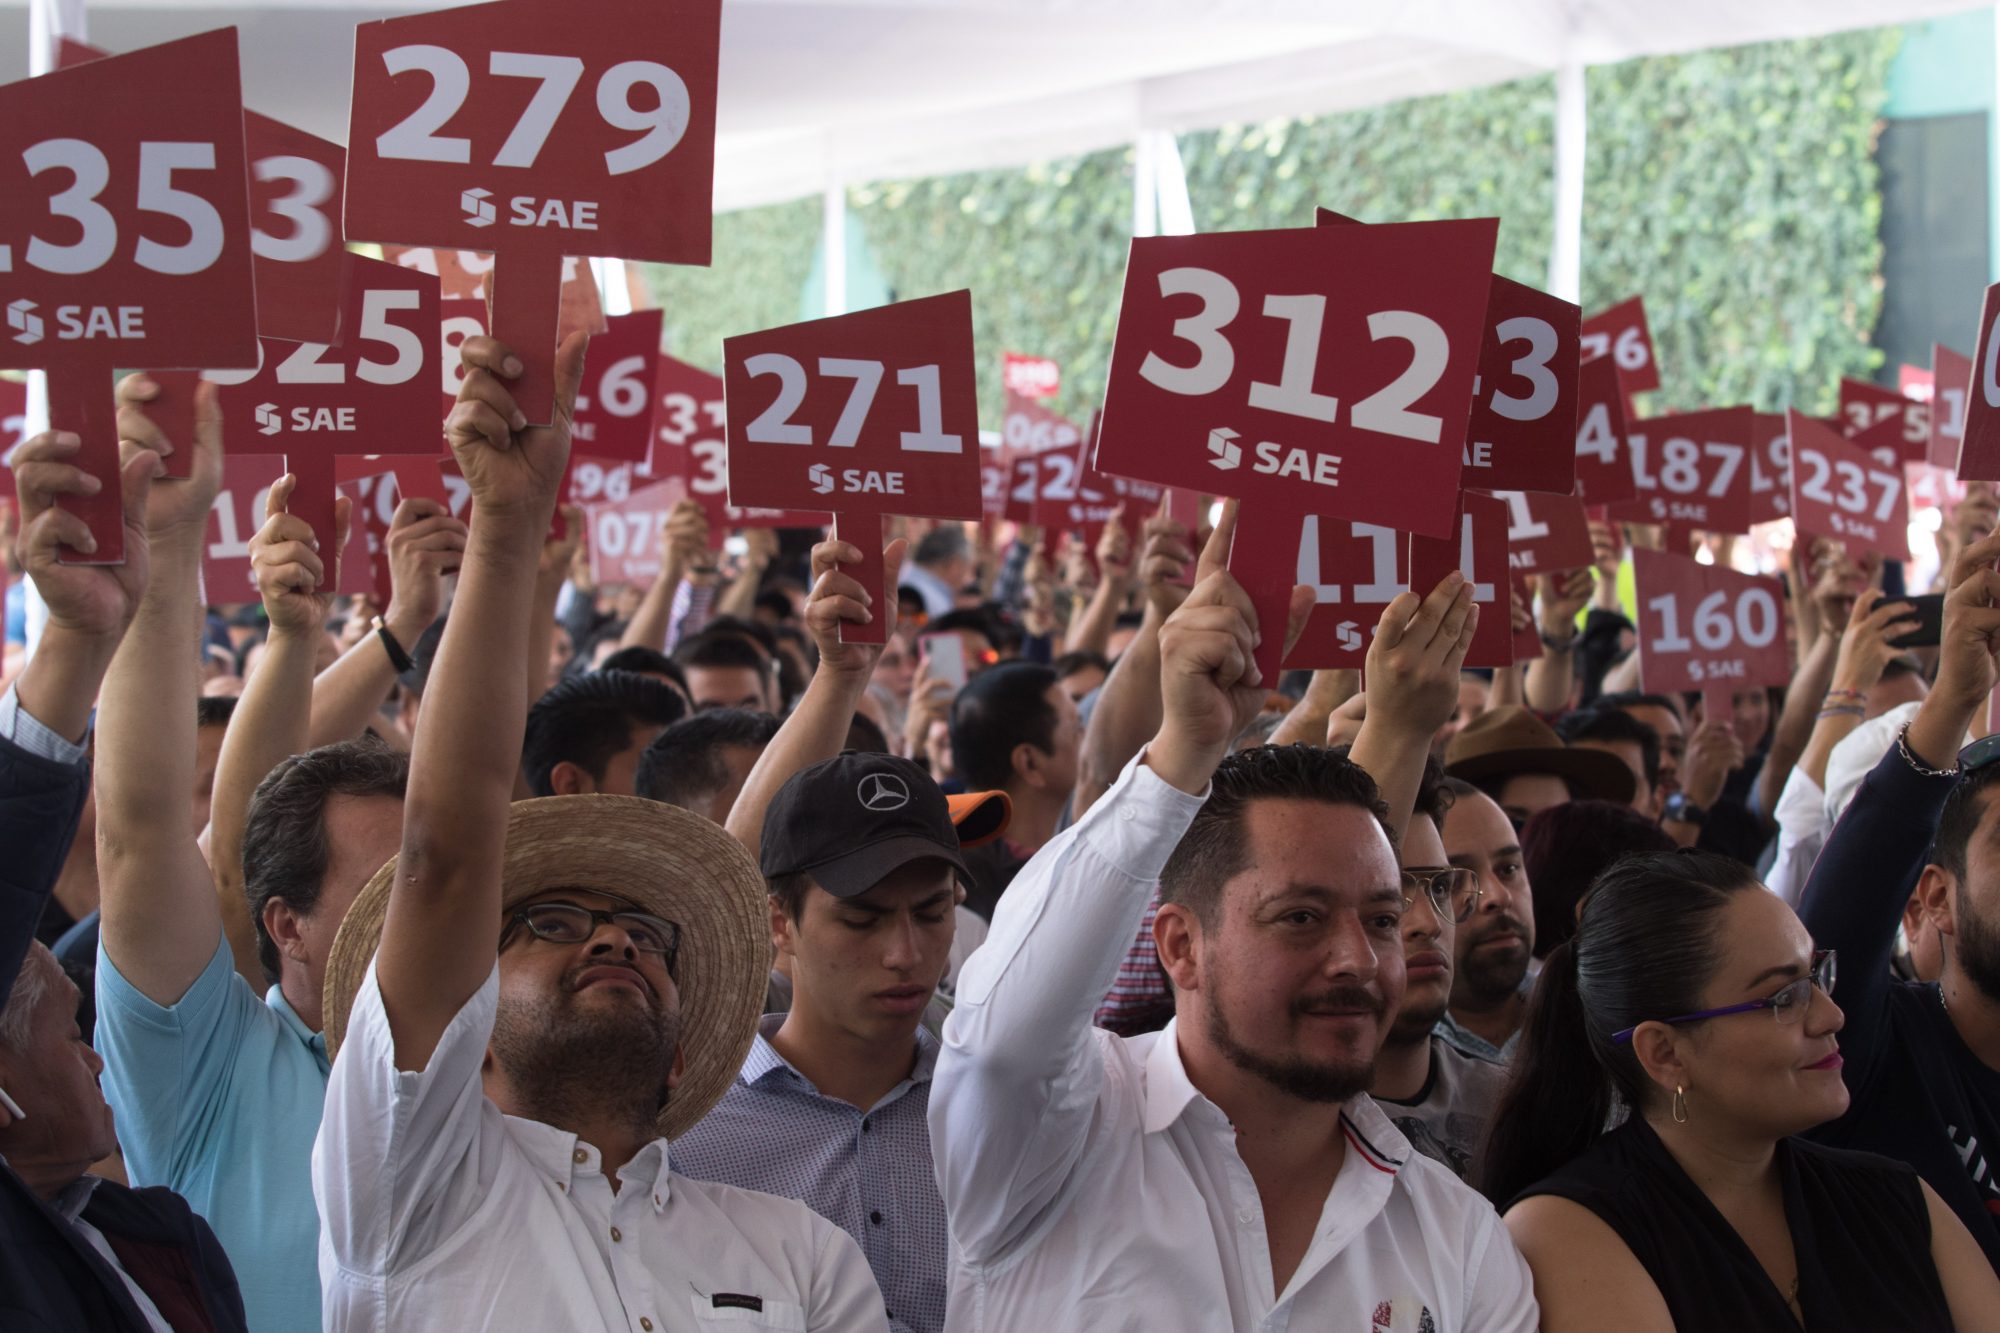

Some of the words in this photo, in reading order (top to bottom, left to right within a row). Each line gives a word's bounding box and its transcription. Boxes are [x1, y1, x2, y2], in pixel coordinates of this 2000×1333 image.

[376, 44, 691, 175] 279
[0, 138, 225, 275] 35
[509, 196, 599, 230] SAE
[56, 305, 146, 339] SAE
[1138, 267, 1450, 444] 312
[1472, 316, 1560, 421] 3
[291, 406, 357, 431] SAE
[743, 353, 963, 453] 271
[842, 469, 905, 494] SAE
[1252, 441, 1343, 487] SAE
[1799, 449, 1901, 523] 237
[1669, 503, 1708, 522] SAE
[1650, 587, 1778, 653] 160
[1707, 660, 1745, 678] SAE
